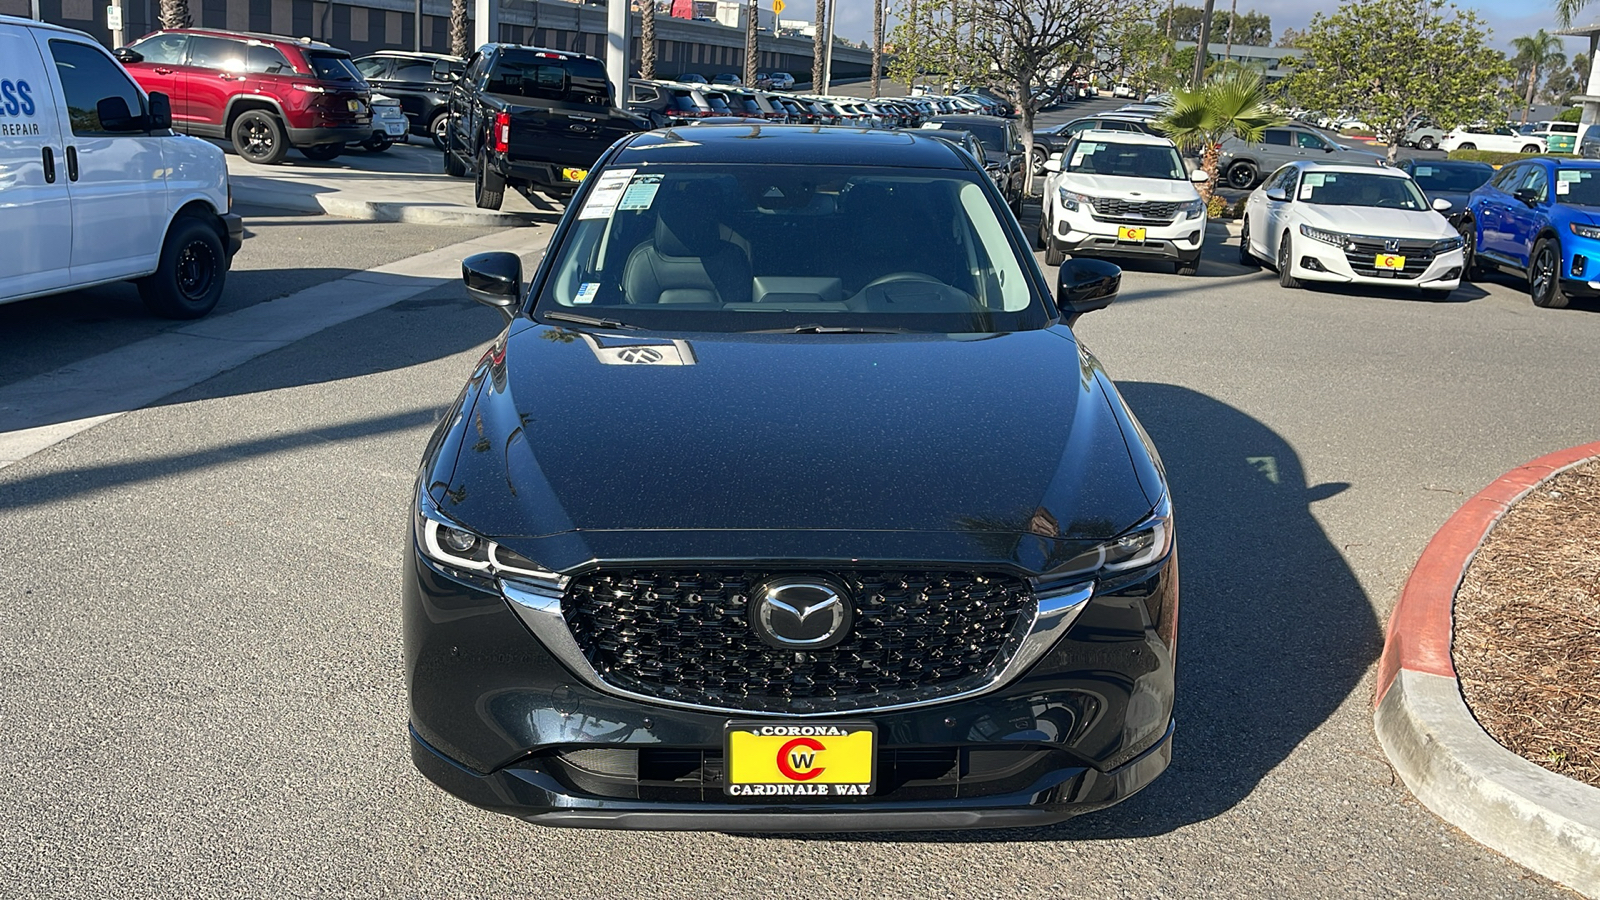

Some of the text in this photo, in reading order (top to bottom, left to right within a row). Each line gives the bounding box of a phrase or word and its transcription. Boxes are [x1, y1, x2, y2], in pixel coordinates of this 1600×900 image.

[2, 123, 40, 136] REPAIR
[761, 725, 840, 736] CORONA
[791, 753, 815, 768] W
[730, 784, 871, 796] CARDINALE WAY
